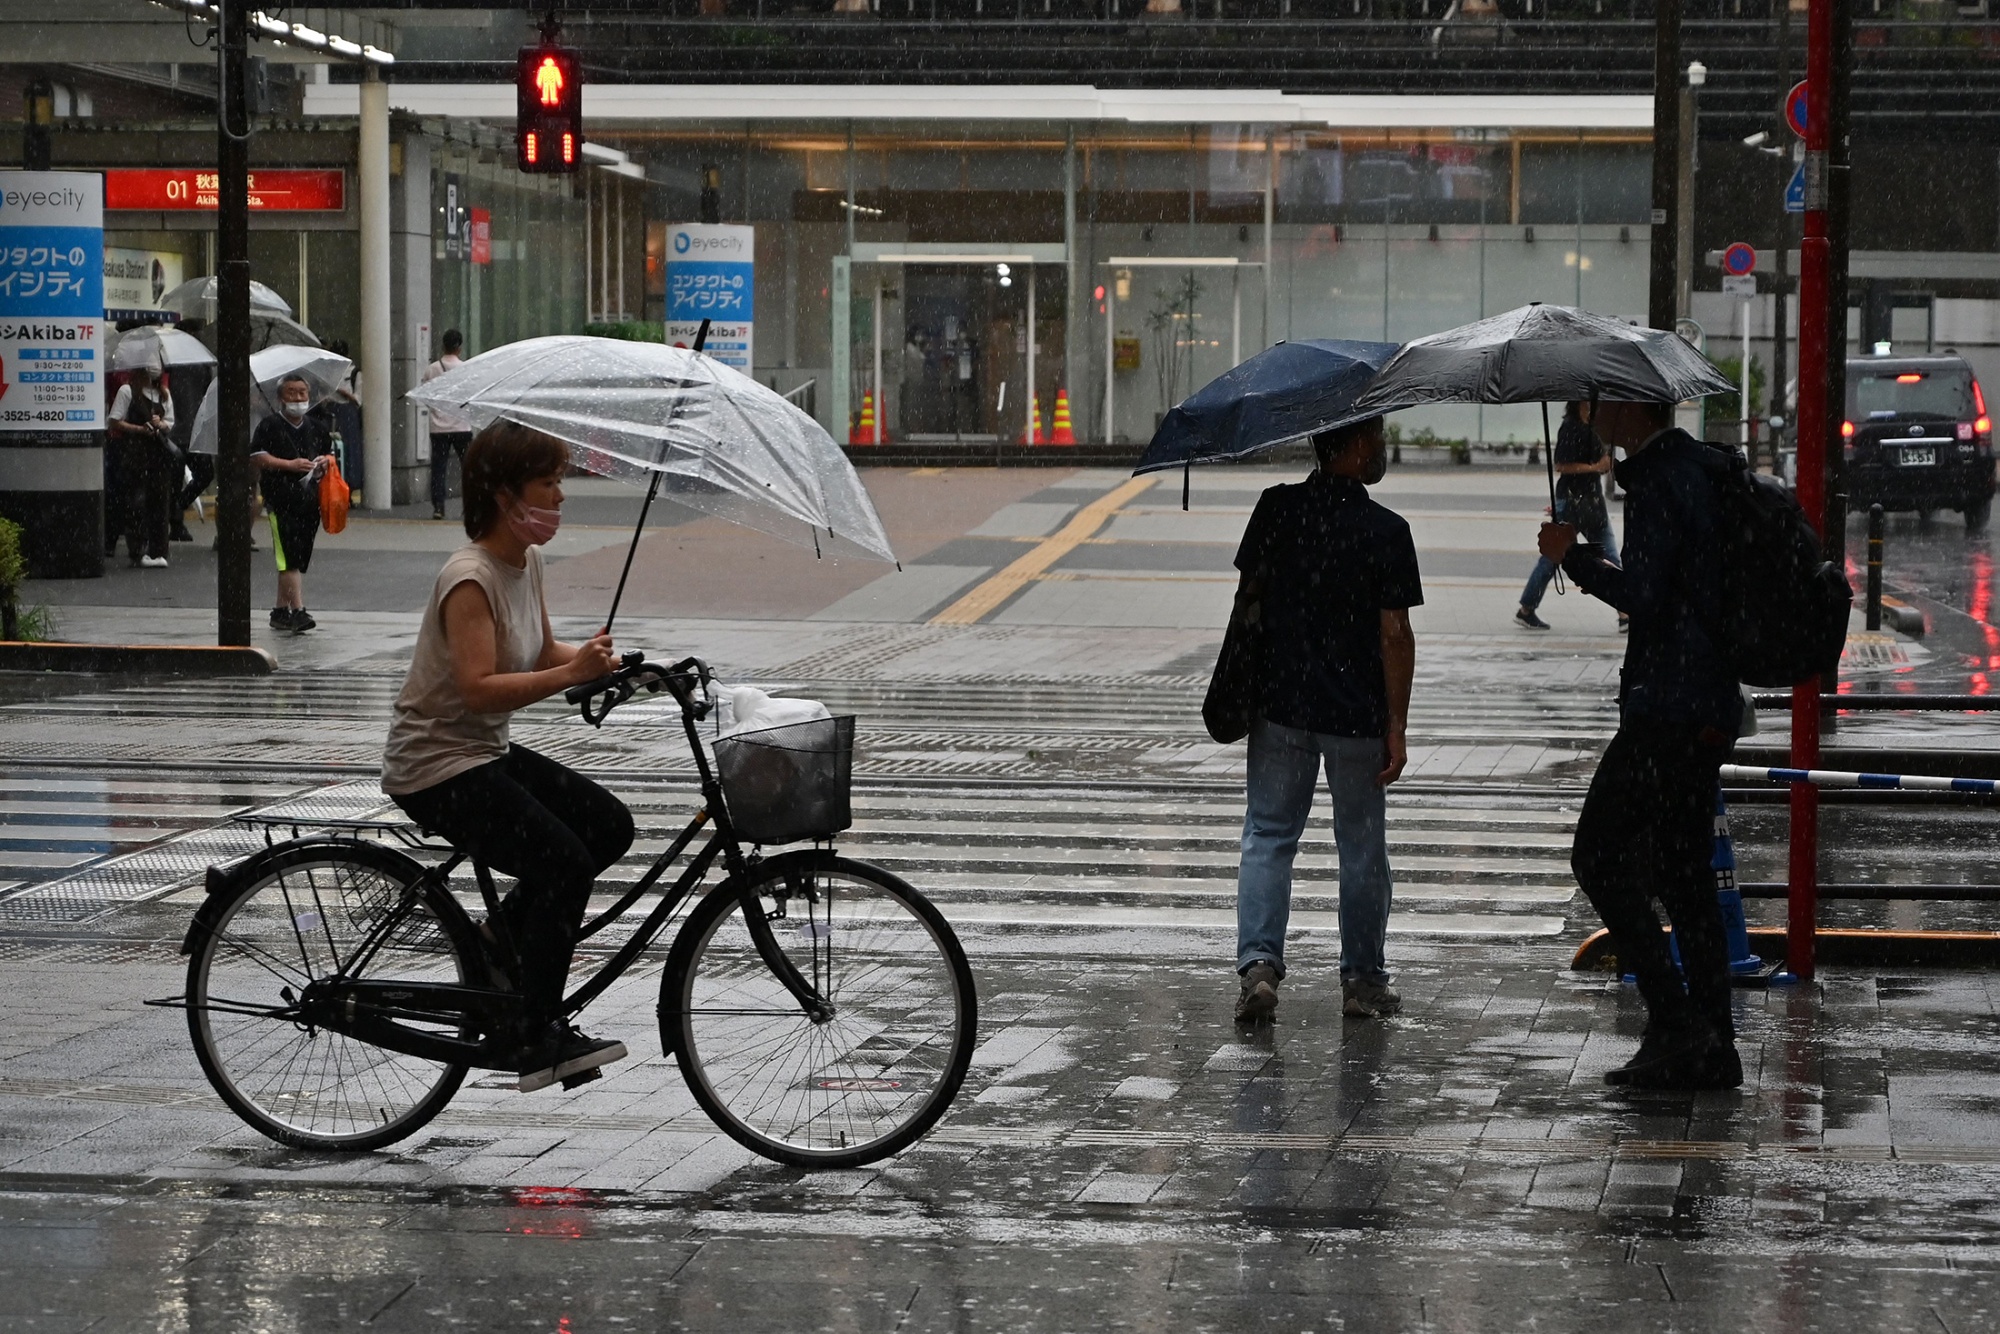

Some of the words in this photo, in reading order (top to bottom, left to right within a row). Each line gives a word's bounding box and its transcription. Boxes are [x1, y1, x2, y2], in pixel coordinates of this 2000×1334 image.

[166, 180, 187, 199] 01
[6, 187, 84, 212] eyecity
[692, 236, 744, 251] eyecity
[673, 275, 744, 288] コンタクトの
[674, 291, 743, 309] アイシティ
